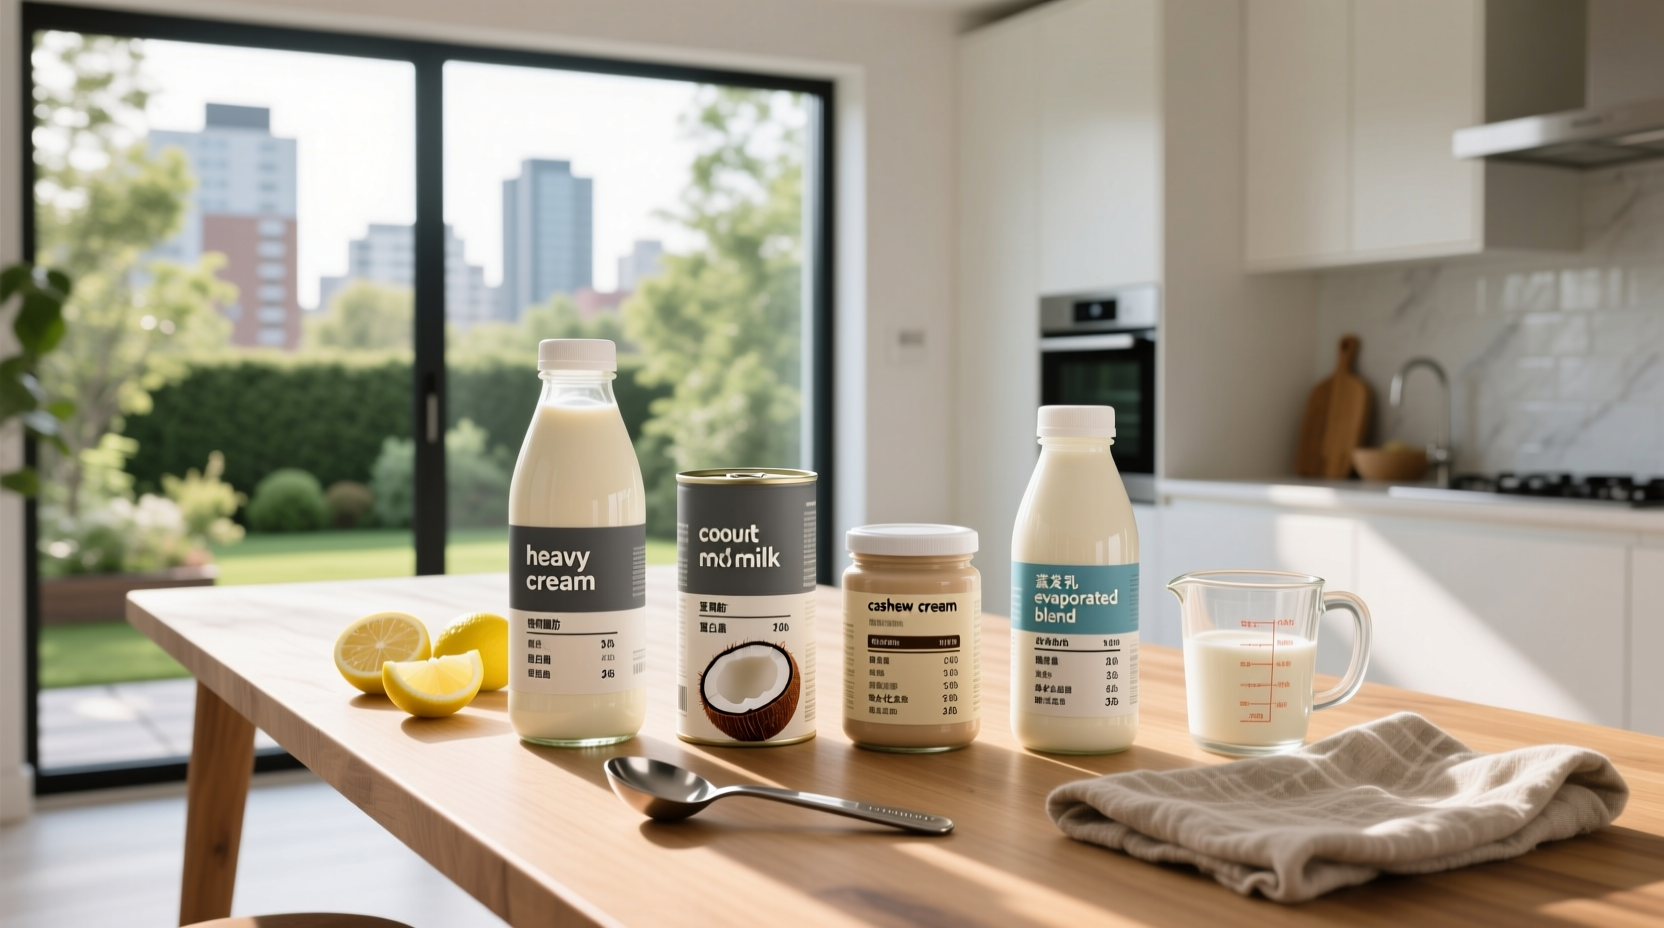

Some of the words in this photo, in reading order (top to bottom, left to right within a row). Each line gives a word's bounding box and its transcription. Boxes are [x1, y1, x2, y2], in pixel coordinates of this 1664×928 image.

[526, 544, 590, 572] heavy
[735, 546, 781, 567] milk
[526, 575, 596, 591] cream
[868, 598, 914, 613] cashew
[918, 601, 957, 613] cream
[1034, 589, 1119, 609] evaporated
[1035, 606, 1077, 623] blend
